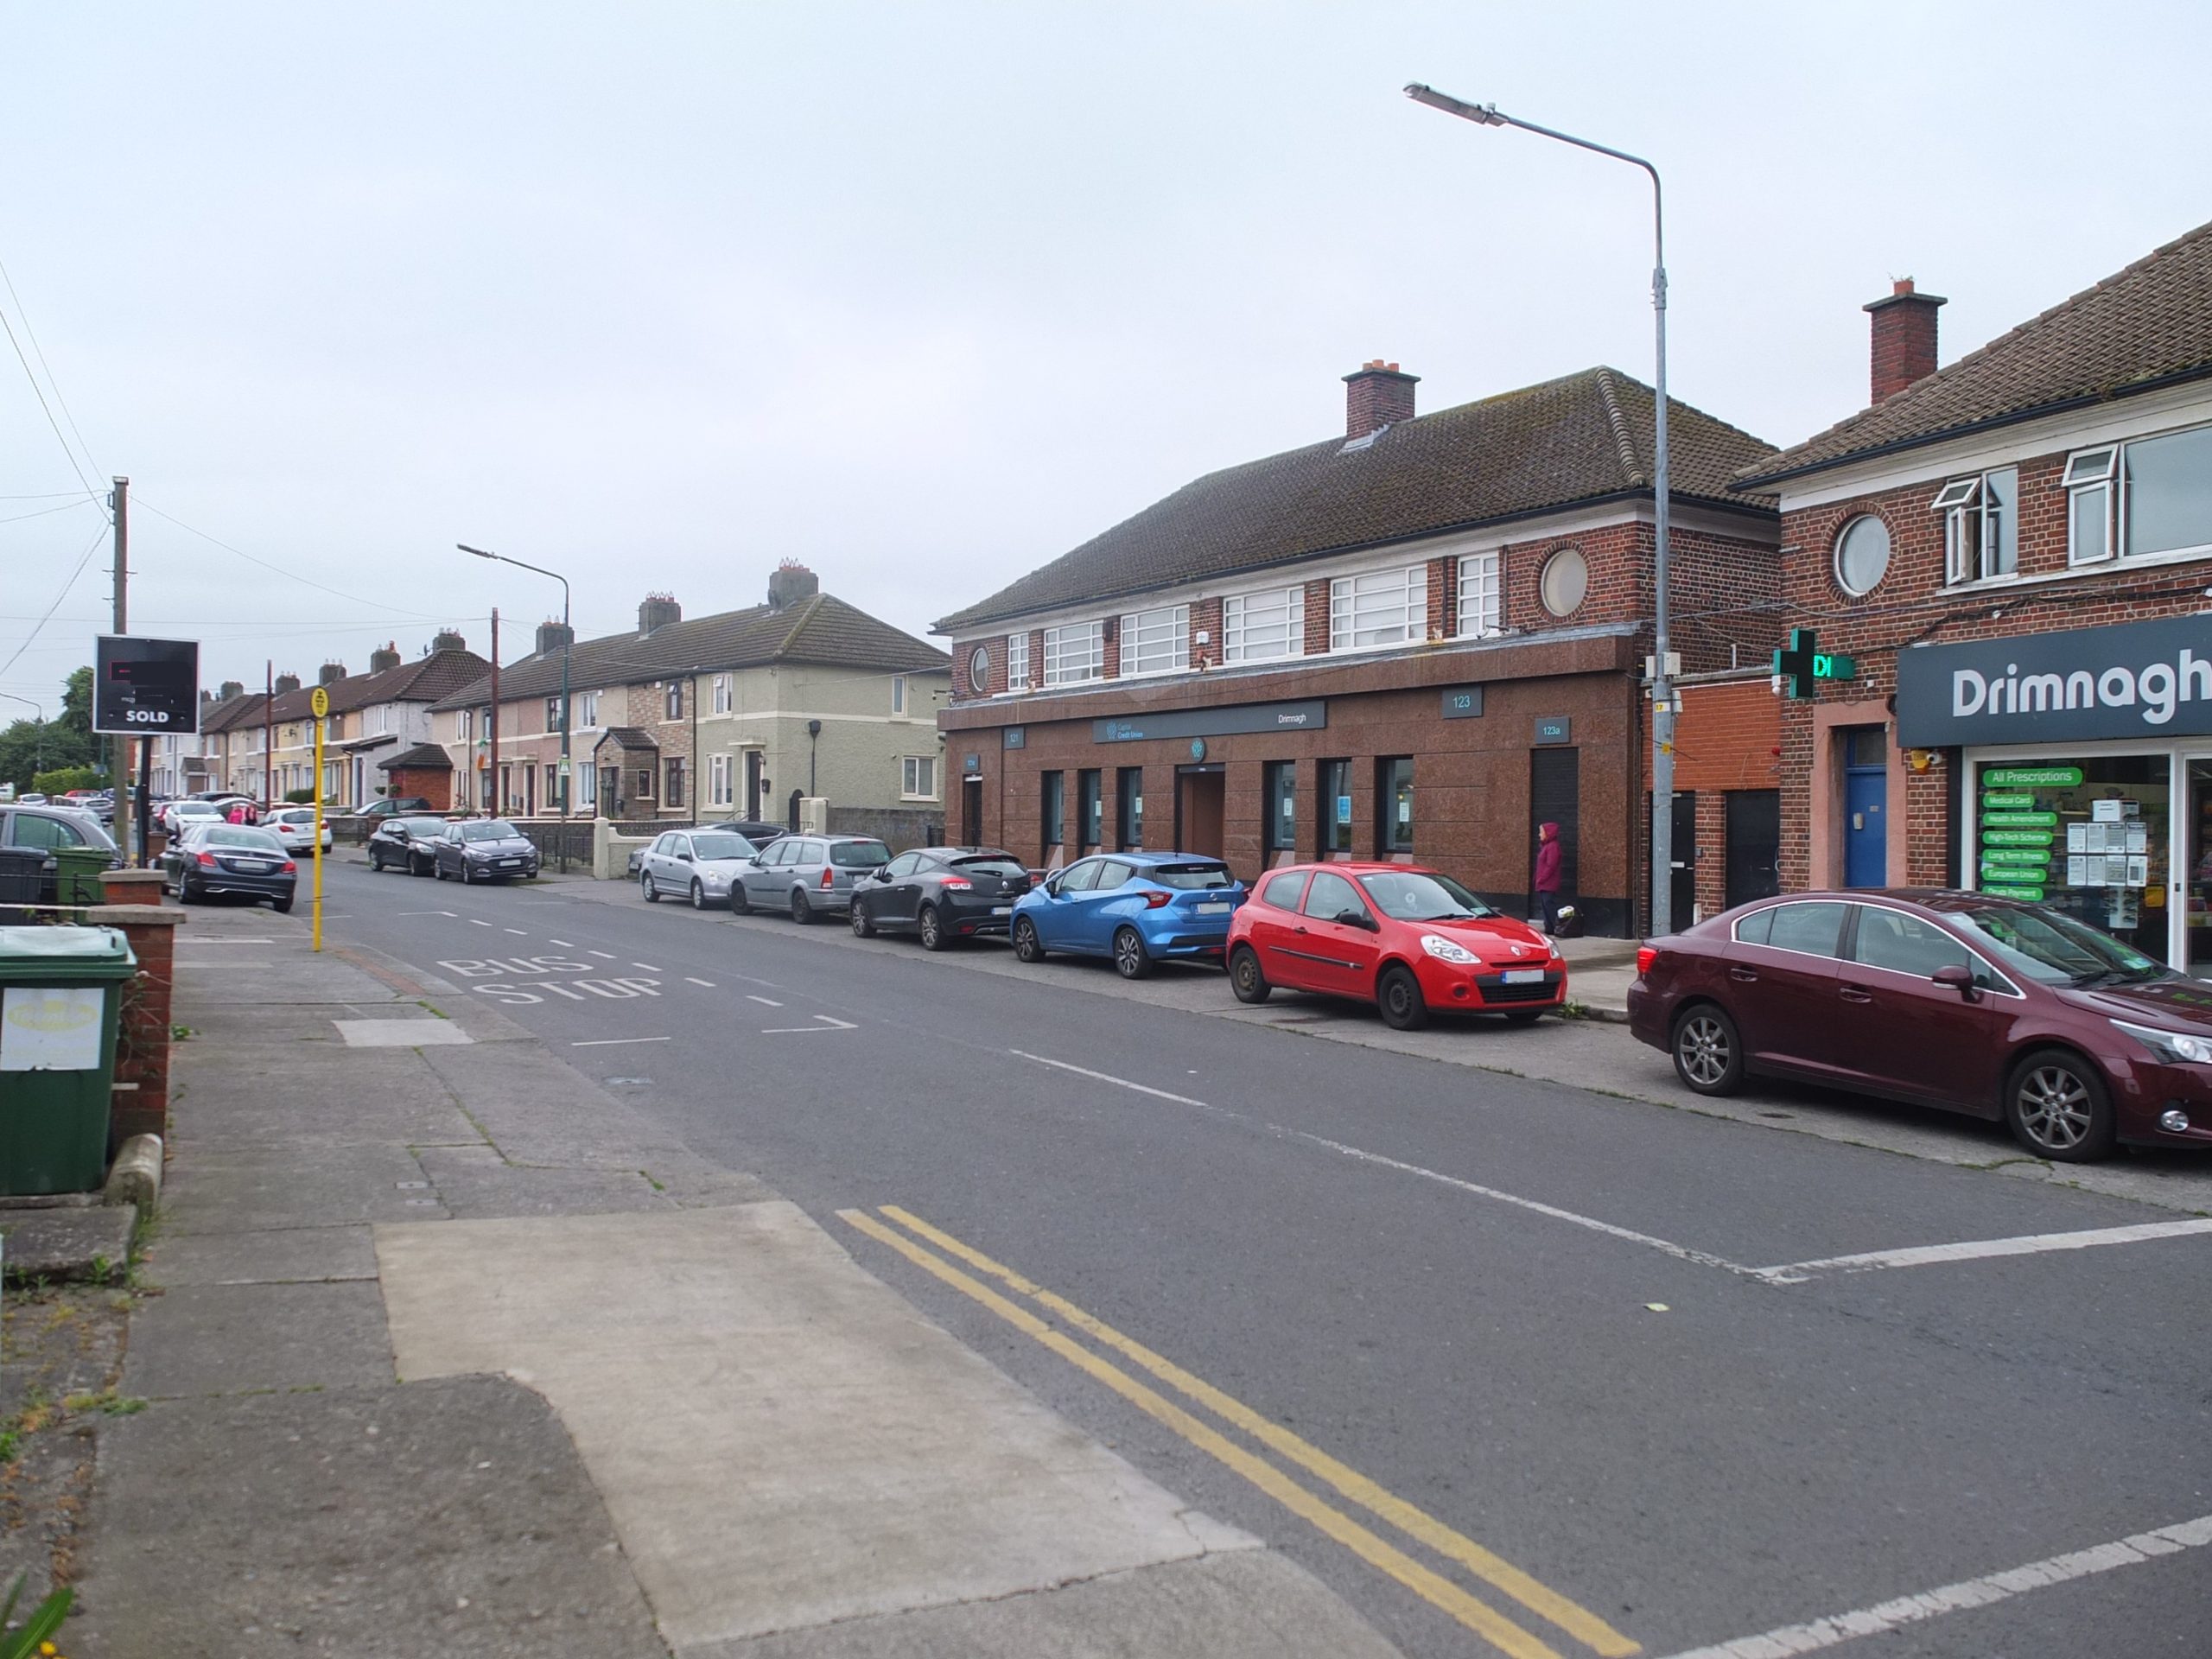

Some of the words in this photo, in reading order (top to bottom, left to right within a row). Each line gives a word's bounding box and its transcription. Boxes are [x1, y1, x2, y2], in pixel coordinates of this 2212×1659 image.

[1953, 648, 2212, 725] Drimnagh
[1452, 695, 1471, 709] 123
[125, 709, 169, 723] SOLD
[1278, 713, 1306, 725] Drimnagh
[1542, 725, 1560, 735] 123a
[1993, 772, 2005, 782] All
[2006, 771, 2073, 783] Prescriptions
[1989, 796, 2014, 804] Medical
[2014, 796, 2031, 804] Card
[2011, 815, 2050, 823] Amendment
[2020, 833, 2047, 842] Scheme
[1988, 851, 2005, 861] Long
[1988, 868, 2018, 879] European
[2019, 869, 2039, 879] Union
[435, 956, 594, 977] BUS
[472, 977, 663, 1005] STOP
